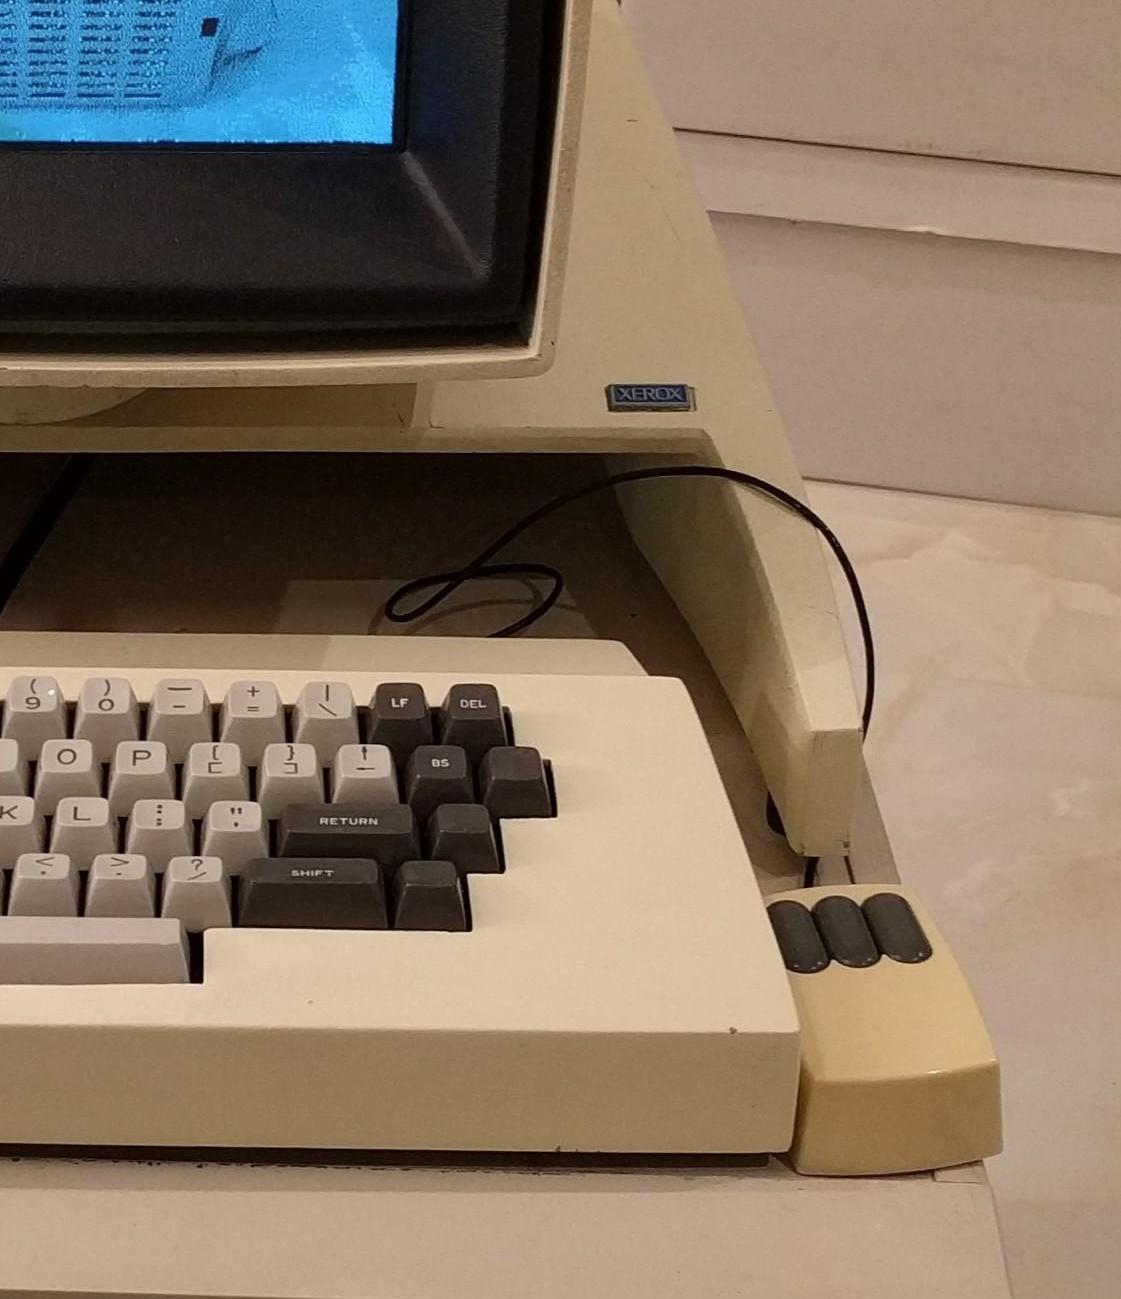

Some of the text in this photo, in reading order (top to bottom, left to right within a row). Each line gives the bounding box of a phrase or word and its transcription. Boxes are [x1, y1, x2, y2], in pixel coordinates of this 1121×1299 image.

[619, 387, 684, 400] XEROX
[25, 696, 41, 710] 9
[391, 697, 409, 708] LF
[460, 698, 486, 709] DEL
[131, 750, 152, 766] P
[431, 757, 450, 768] BS
[72, 805, 92, 821] L
[319, 816, 379, 826] RETURN
[190, 858, 204, 871] ?
[291, 869, 334, 878] SHIFT
